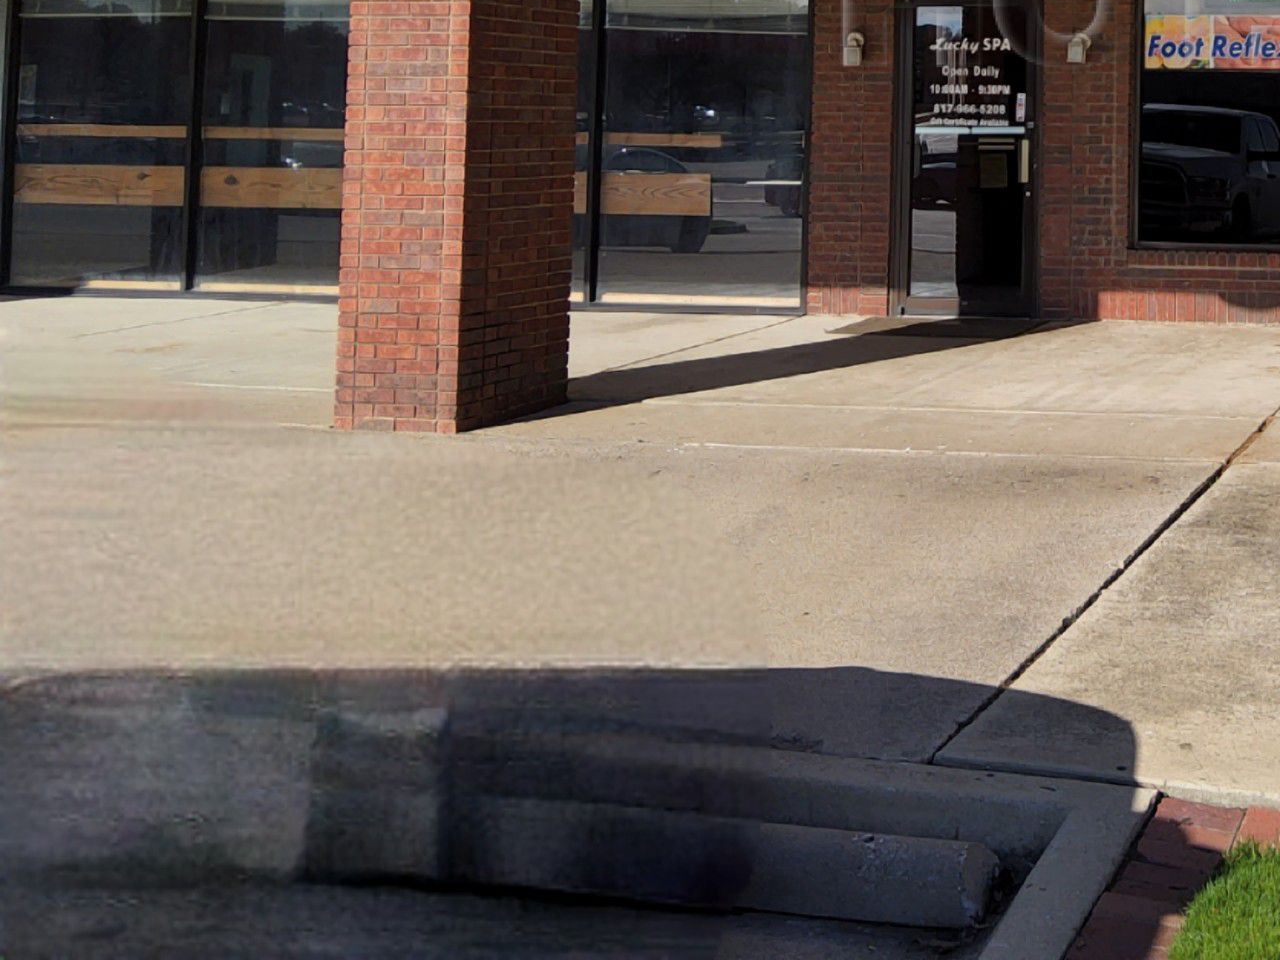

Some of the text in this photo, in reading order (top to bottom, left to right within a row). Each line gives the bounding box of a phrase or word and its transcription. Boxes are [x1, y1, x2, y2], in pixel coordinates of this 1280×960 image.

[929, 37, 1011, 54] Lucky SPA
[1148, 35, 1204, 58] Foot
[942, 65, 1000, 78] Open Daily
